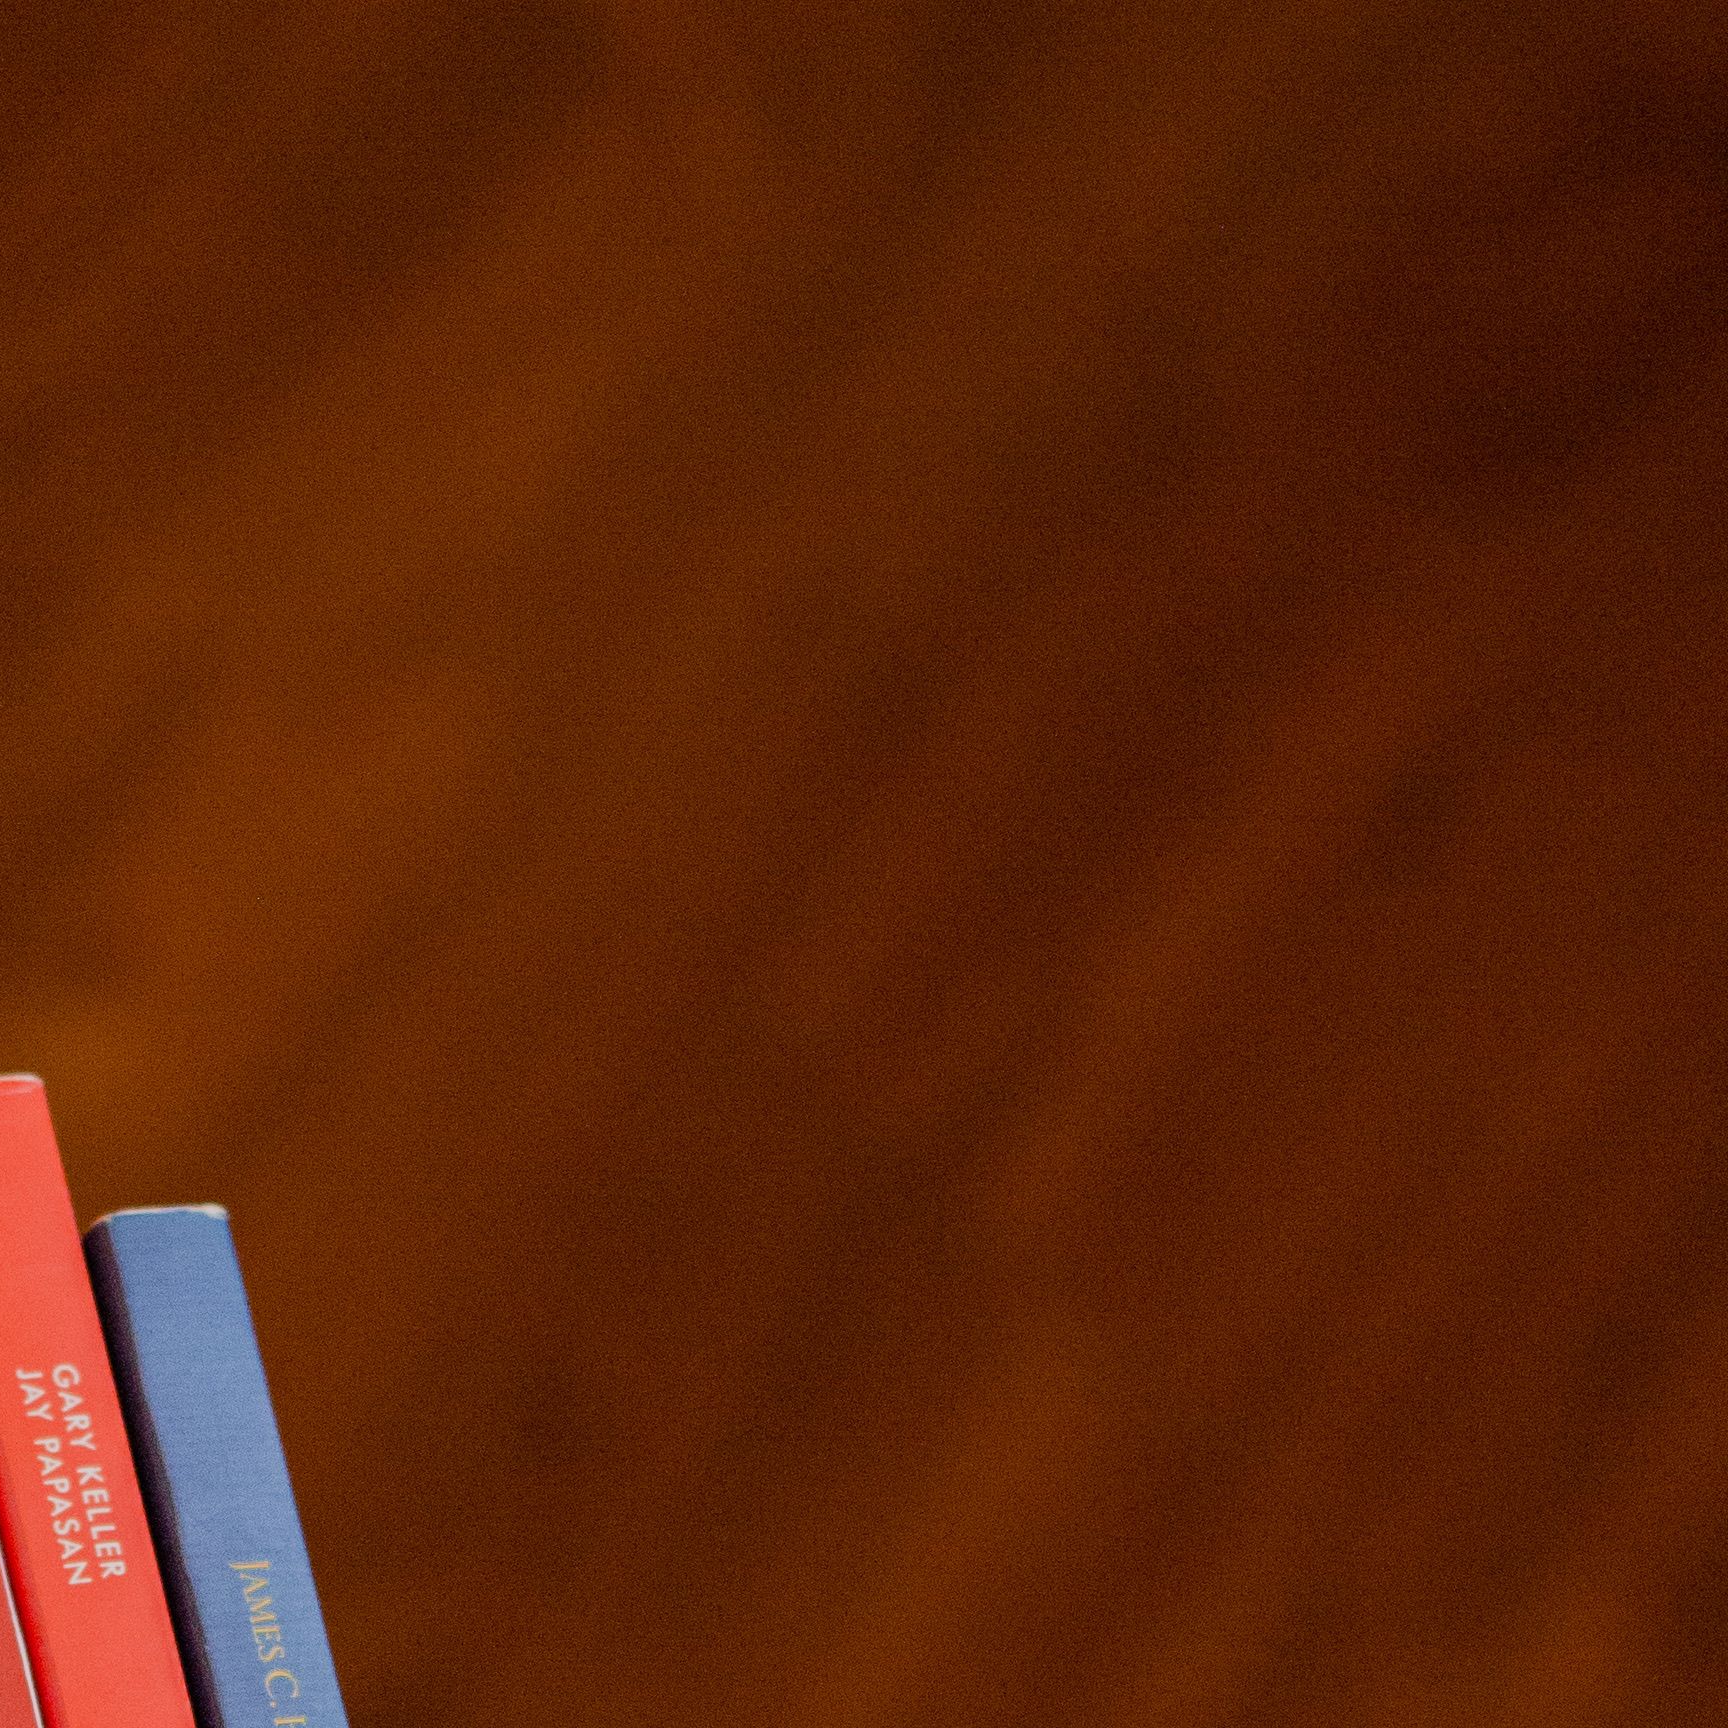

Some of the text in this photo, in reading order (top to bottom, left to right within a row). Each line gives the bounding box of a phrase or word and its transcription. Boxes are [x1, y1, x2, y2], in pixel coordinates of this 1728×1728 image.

[15, 1368, 92, 1586] JAY PAPASAN
[52, 1363, 126, 1579] GARY KELLER
[229, 1560, 286, 1663] JAMES
